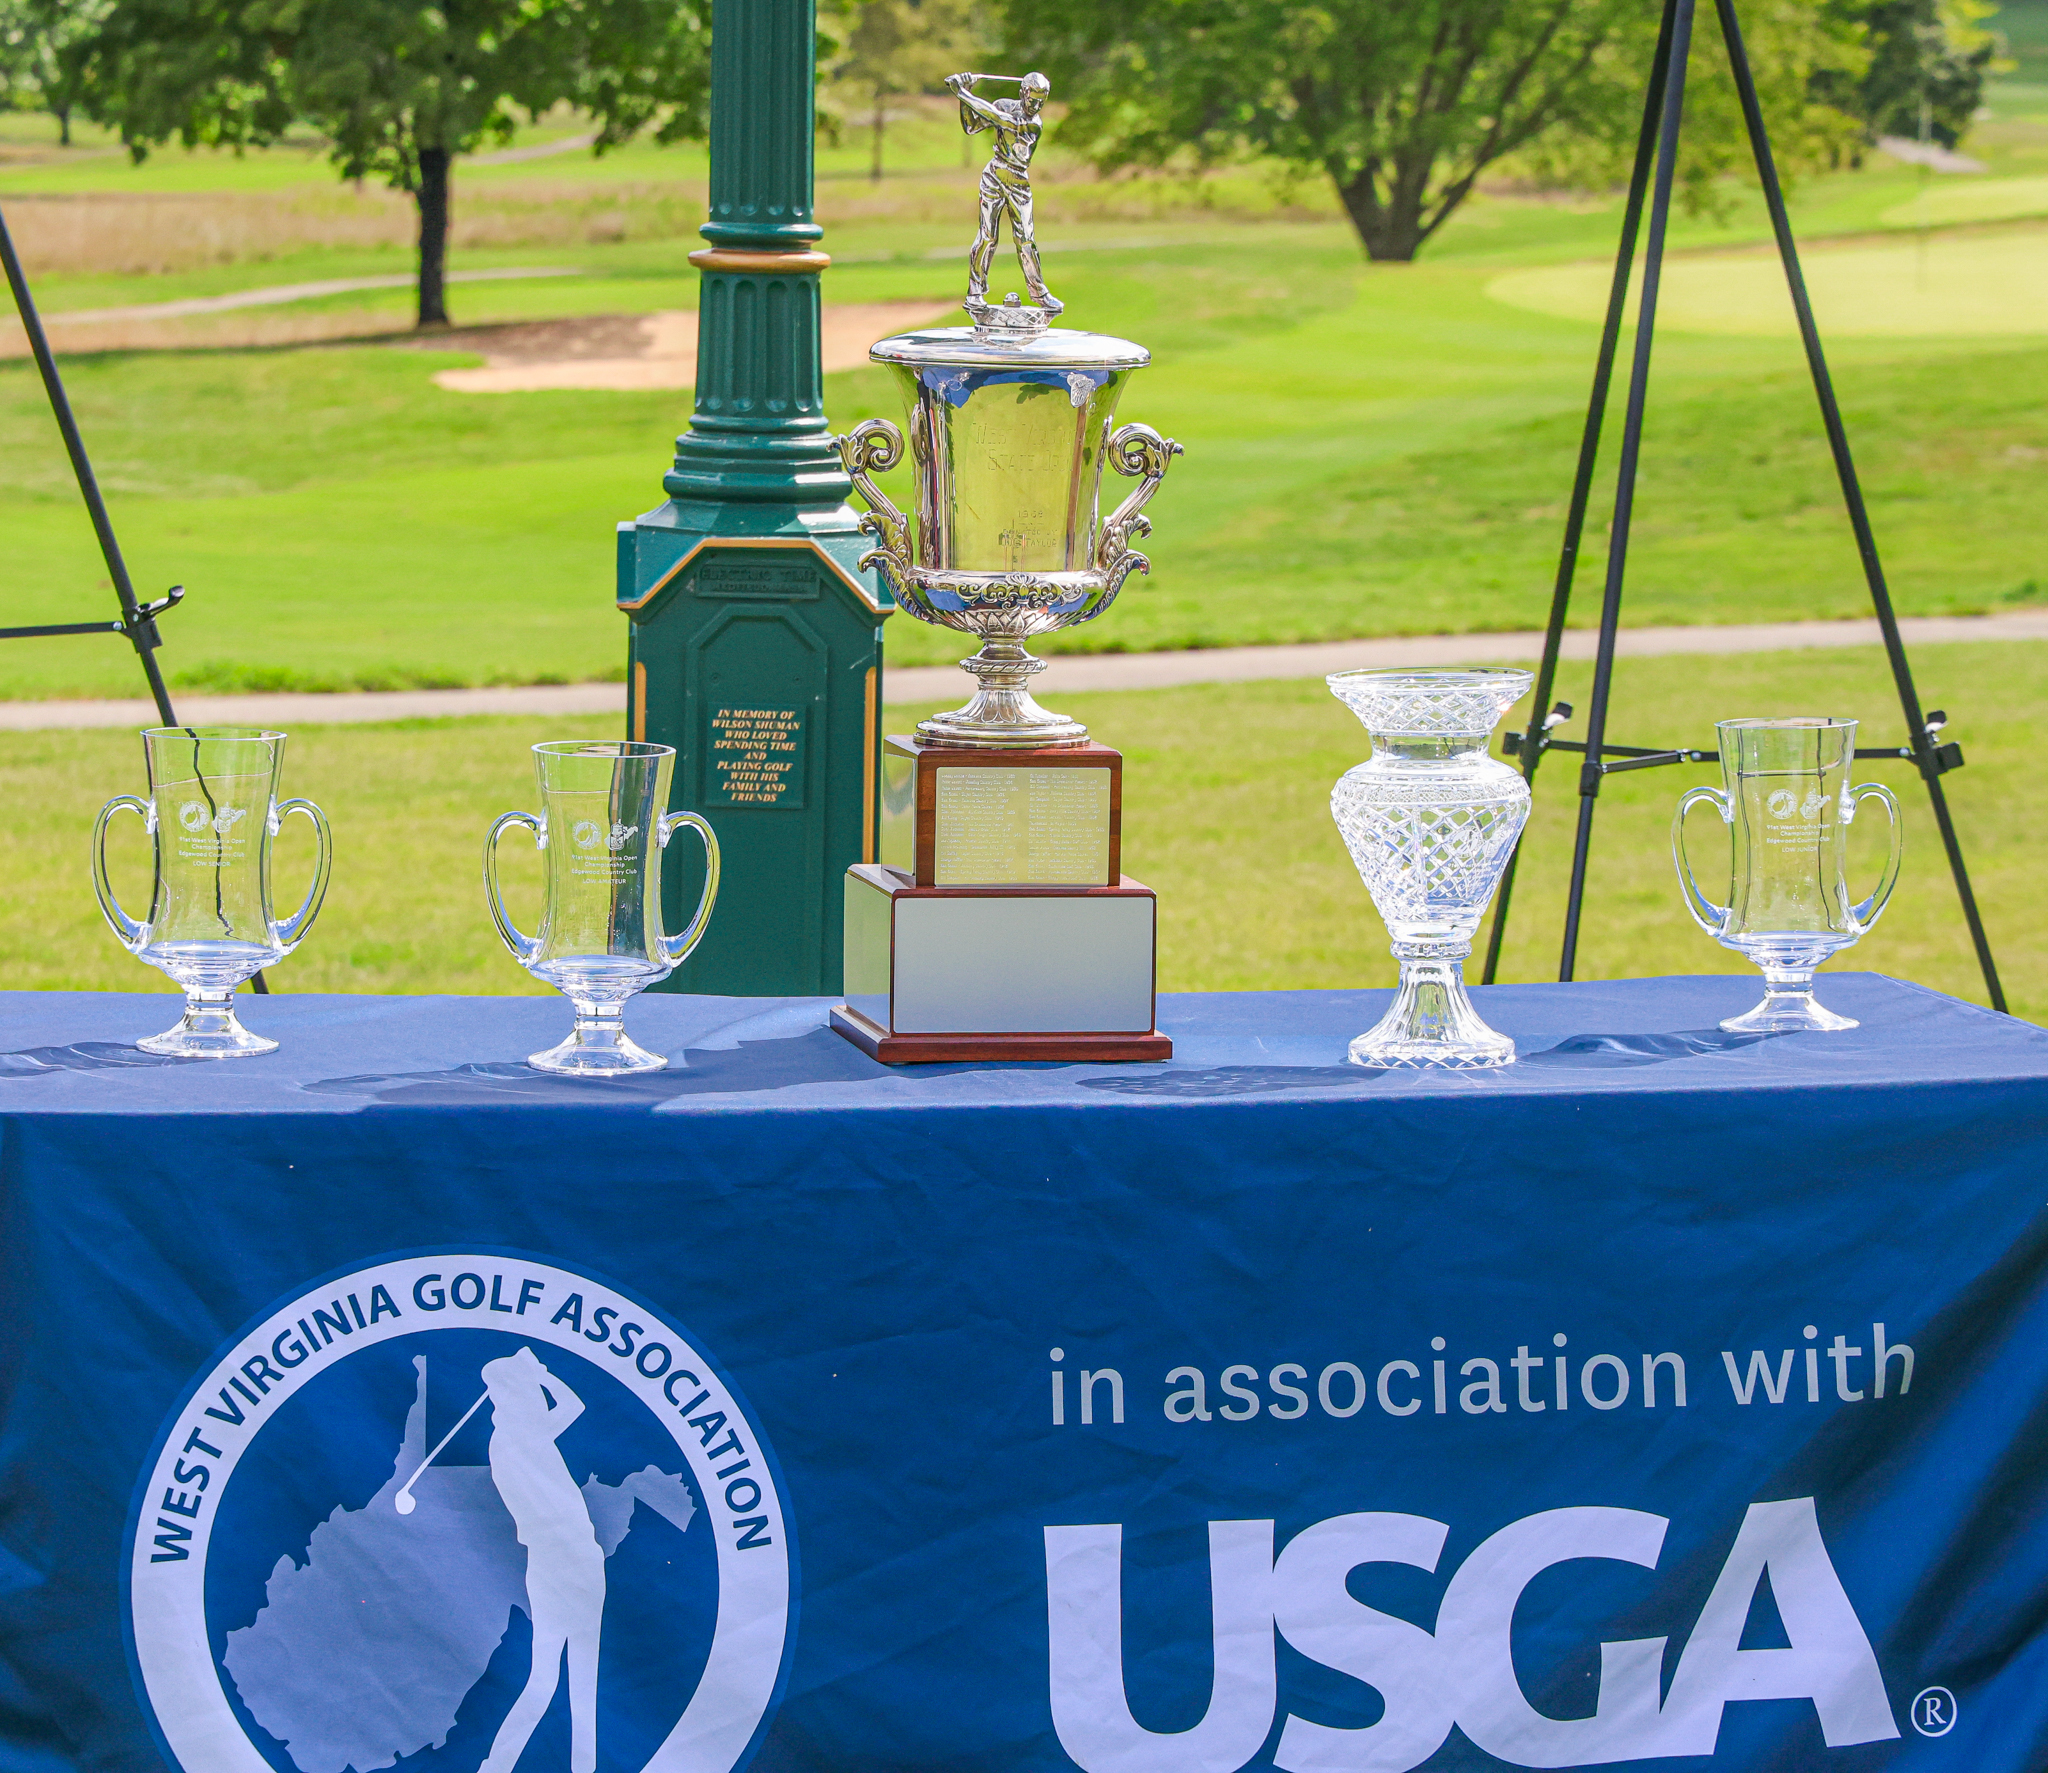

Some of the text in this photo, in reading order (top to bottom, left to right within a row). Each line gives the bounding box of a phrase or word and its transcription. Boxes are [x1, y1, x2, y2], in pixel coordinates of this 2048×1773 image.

[717, 709, 796, 720] IN MEMORY OF
[712, 719, 801, 731] WILSON SHUMAN
[725, 730, 788, 741] WHO LOVED
[714, 740, 797, 751] SPENDING TIME
[744, 751, 767, 761] AND
[717, 761, 794, 772] PLAYING GOLF
[730, 772, 779, 782] WITH HIS
[722, 782, 786, 792] FAMILY AND
[731, 793, 778, 803] FRIENDS
[1050, 1323, 1914, 1425] in association with
[150, 1272, 772, 1563] WEST VIRGINIA GOLF ASSOCIATION
[1044, 1496, 1902, 1773] USGA
